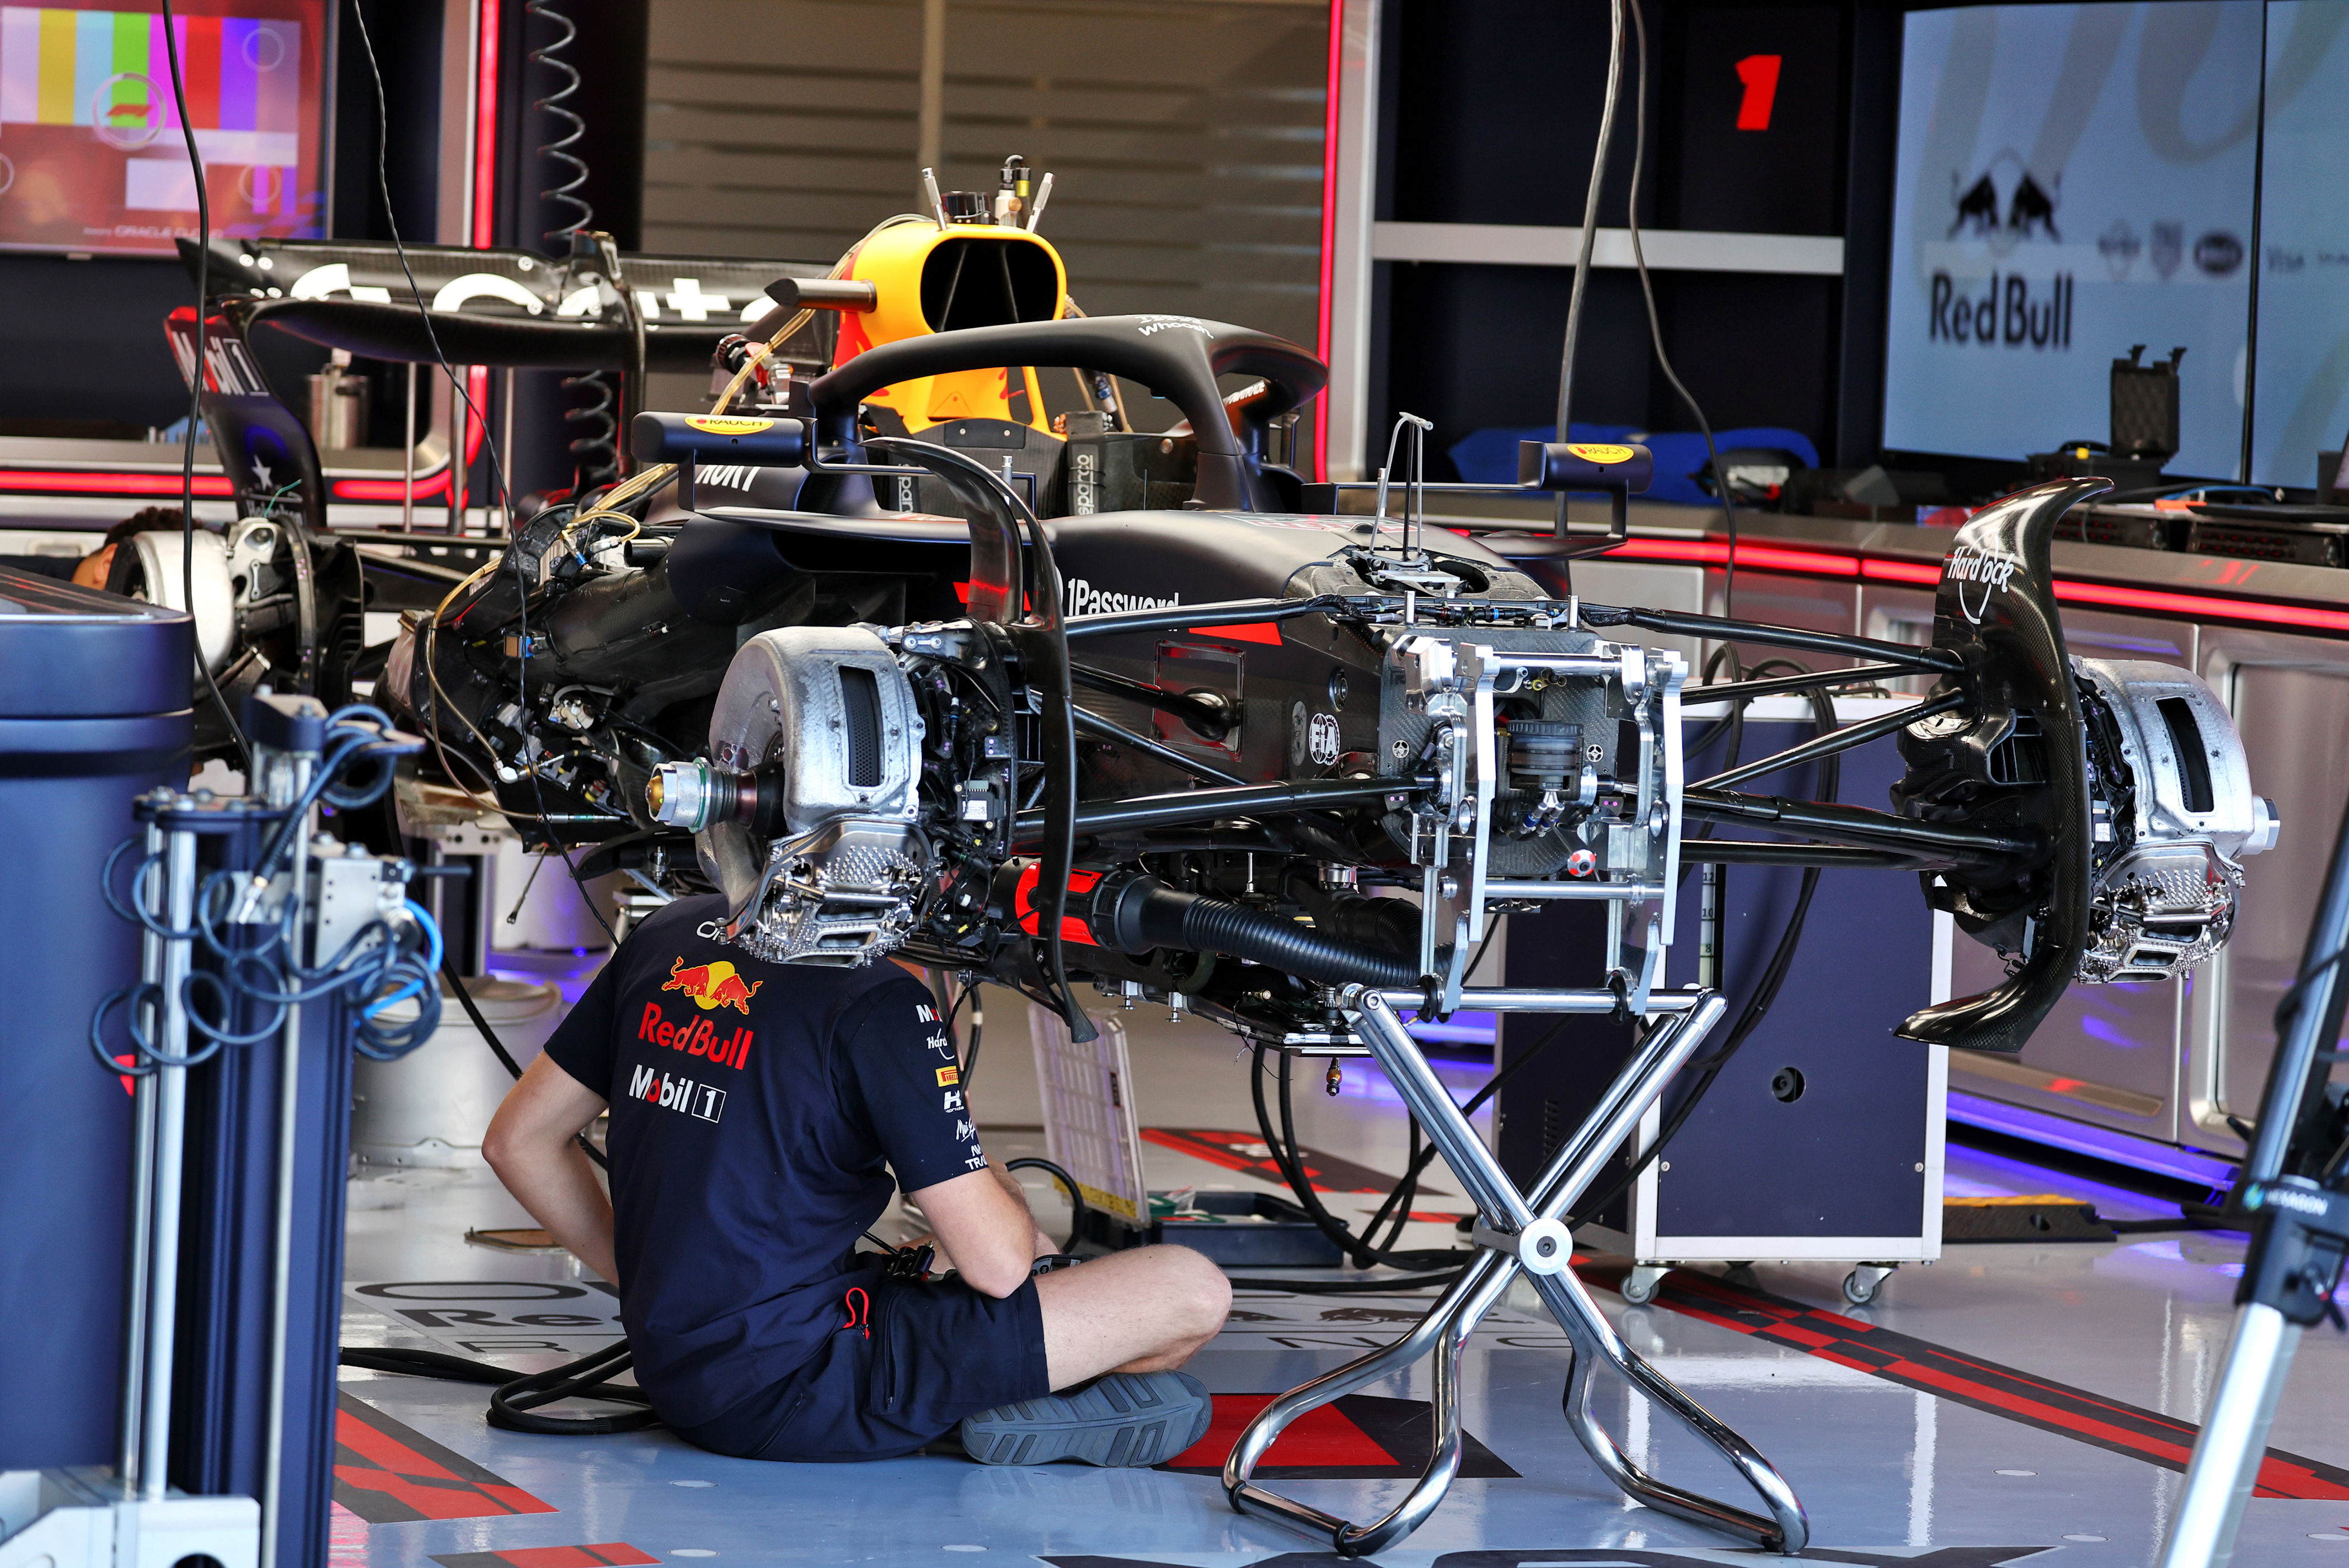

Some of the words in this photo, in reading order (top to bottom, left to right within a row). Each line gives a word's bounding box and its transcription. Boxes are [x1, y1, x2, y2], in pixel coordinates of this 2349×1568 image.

[1735, 54, 1782, 131] 1
[1930, 270, 1998, 343] Red
[2004, 273, 2074, 348] Bull
[1584, 446, 1625, 454] RAUCH
[1704, 872, 1714, 881] 12
[1702, 908, 1713, 917] 10
[1705, 944, 1712, 953] 8
[941, 1069, 958, 1082] PIRELL
[629, 1064, 694, 1114] Mobil
